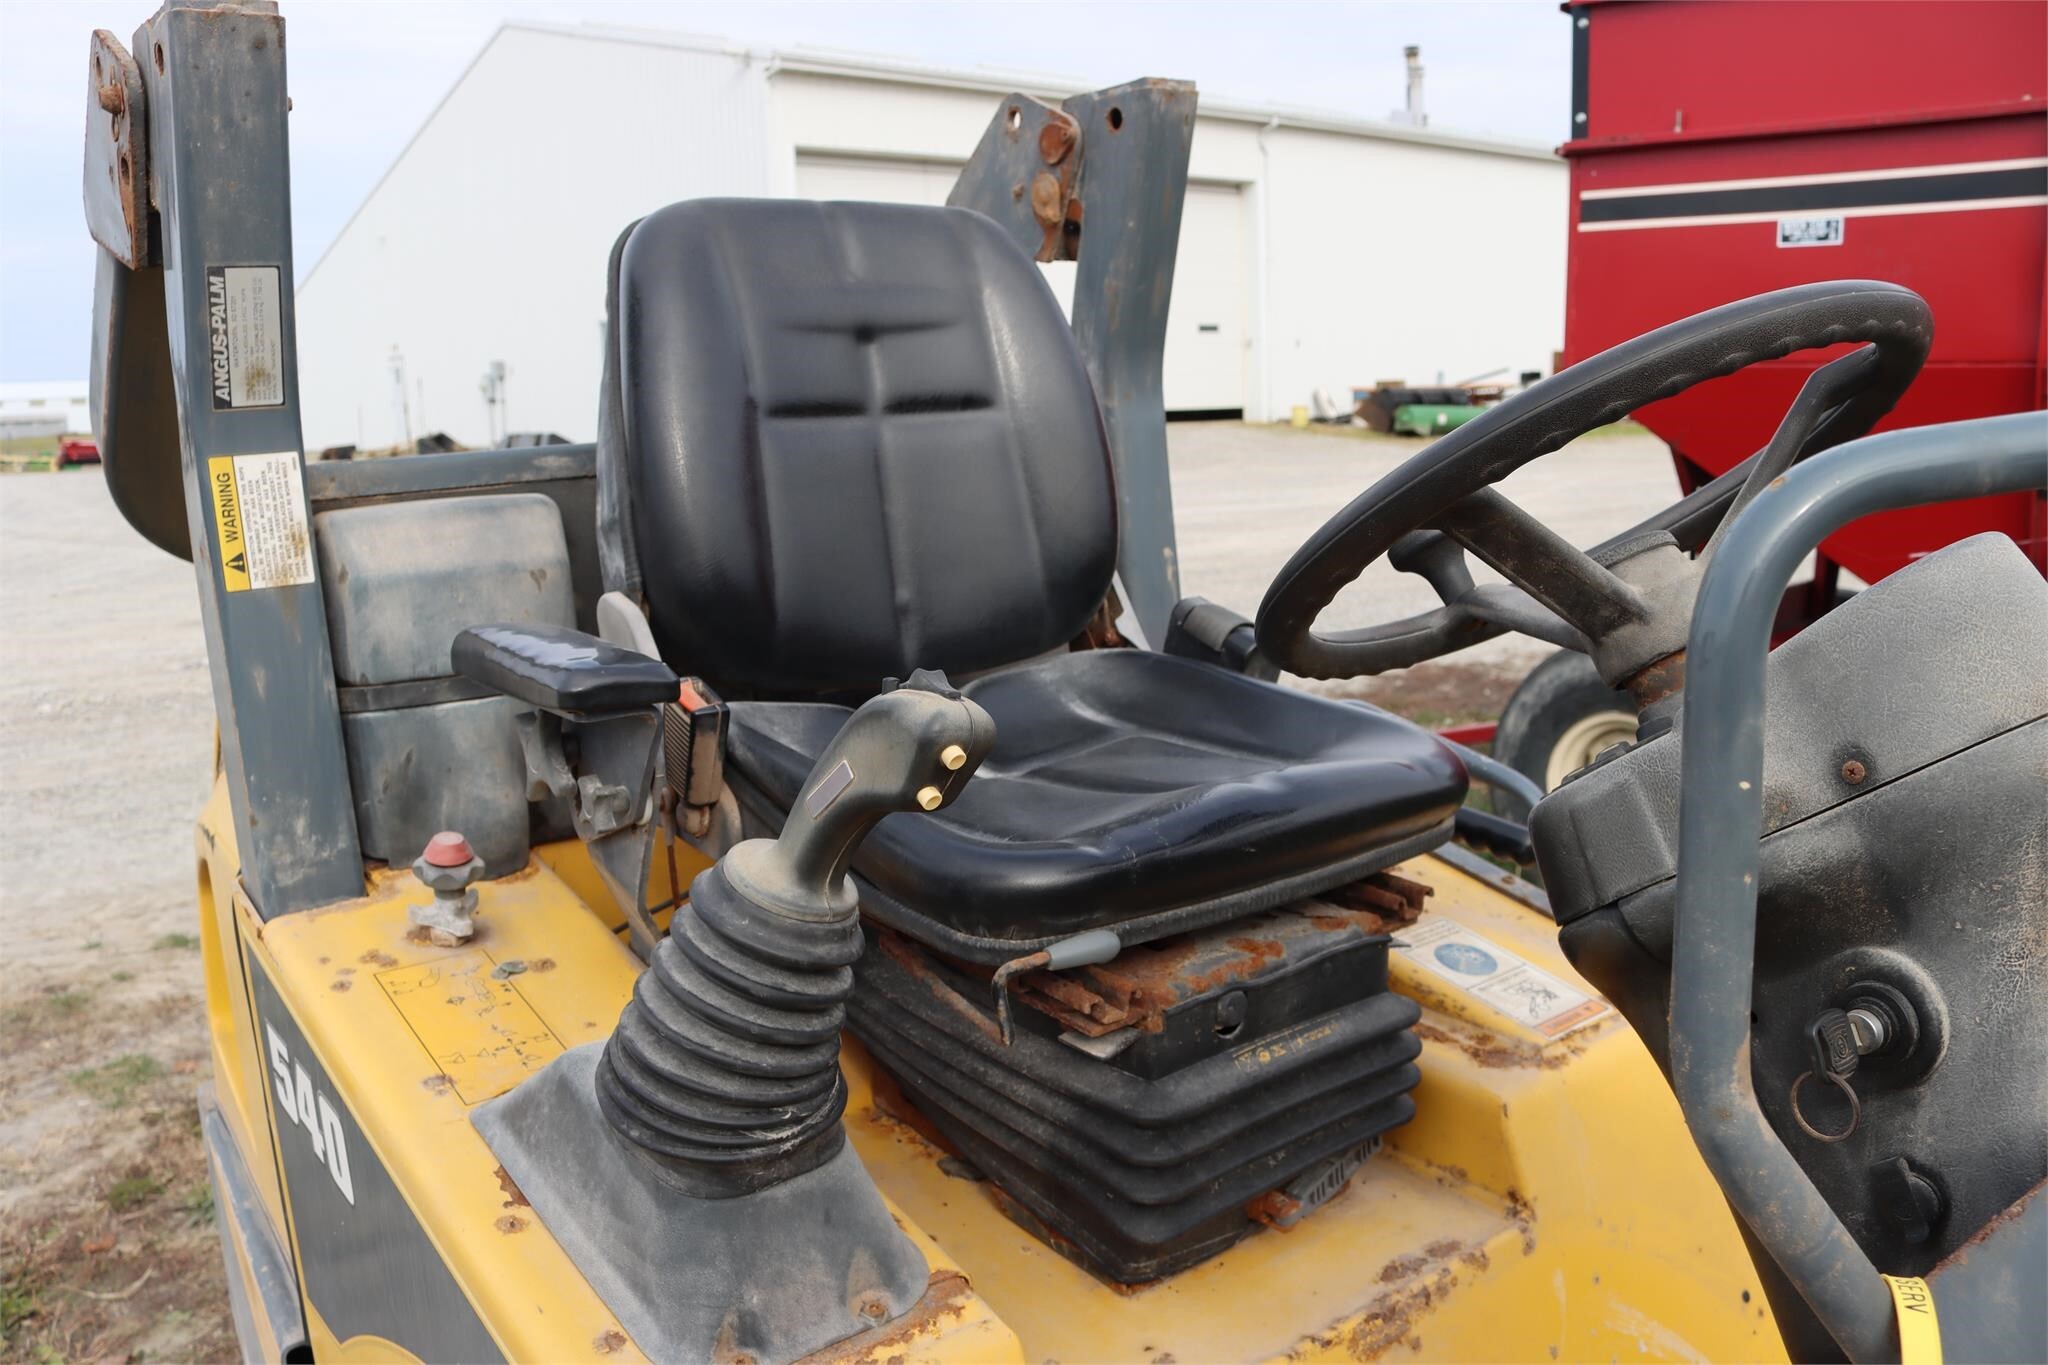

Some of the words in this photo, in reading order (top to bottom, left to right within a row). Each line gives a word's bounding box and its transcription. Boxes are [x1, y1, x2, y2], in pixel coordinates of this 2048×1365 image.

[208, 275, 230, 401] ANGUS-PALM
[215, 471, 239, 543] WARNING
[266, 1019, 355, 1206] 540
